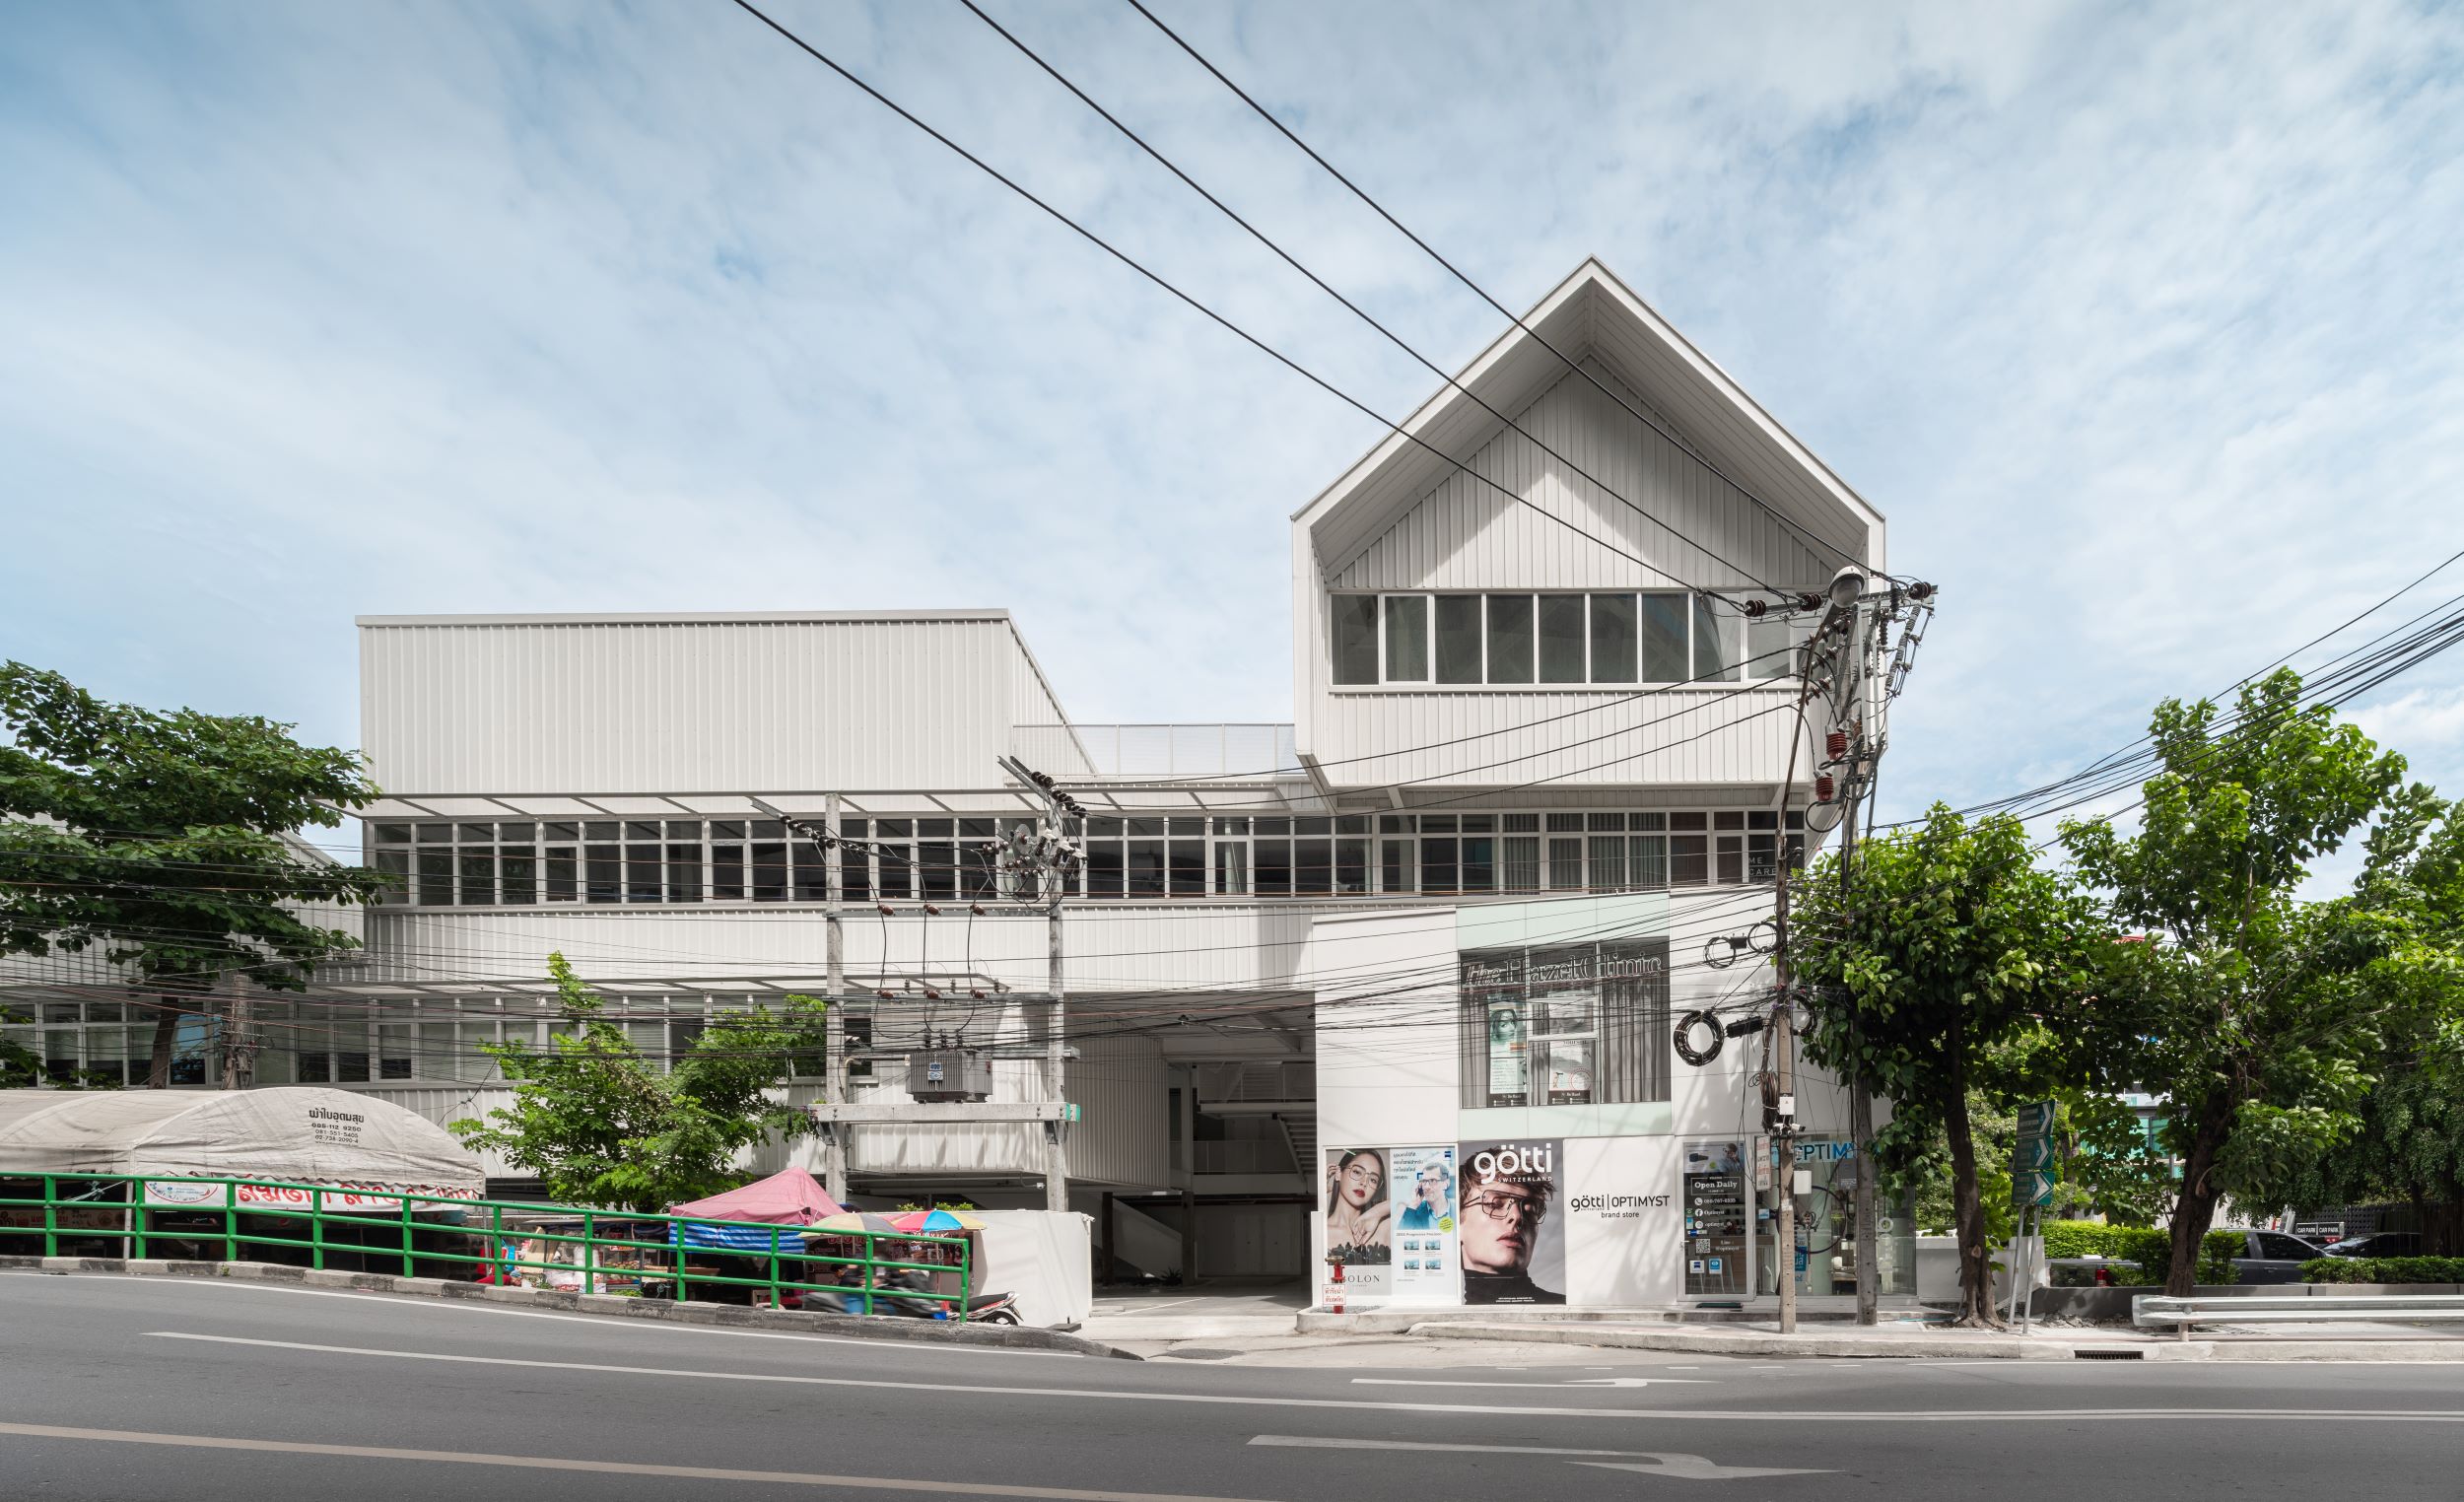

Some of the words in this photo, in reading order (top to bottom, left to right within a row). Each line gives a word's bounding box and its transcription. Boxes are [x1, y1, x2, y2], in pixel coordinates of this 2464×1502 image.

[1504, 955, 1581, 984] Hazel
[1582, 951, 1662, 979] Clinic
[308, 1107, 365, 1125] ผ้าใบอุดมสุข
[1473, 1142, 1552, 1185] götti
[1570, 1195, 1605, 1212] götti
[1611, 1195, 1671, 1207] OPTIMYST
[1344, 1274, 1380, 1283] OLON
